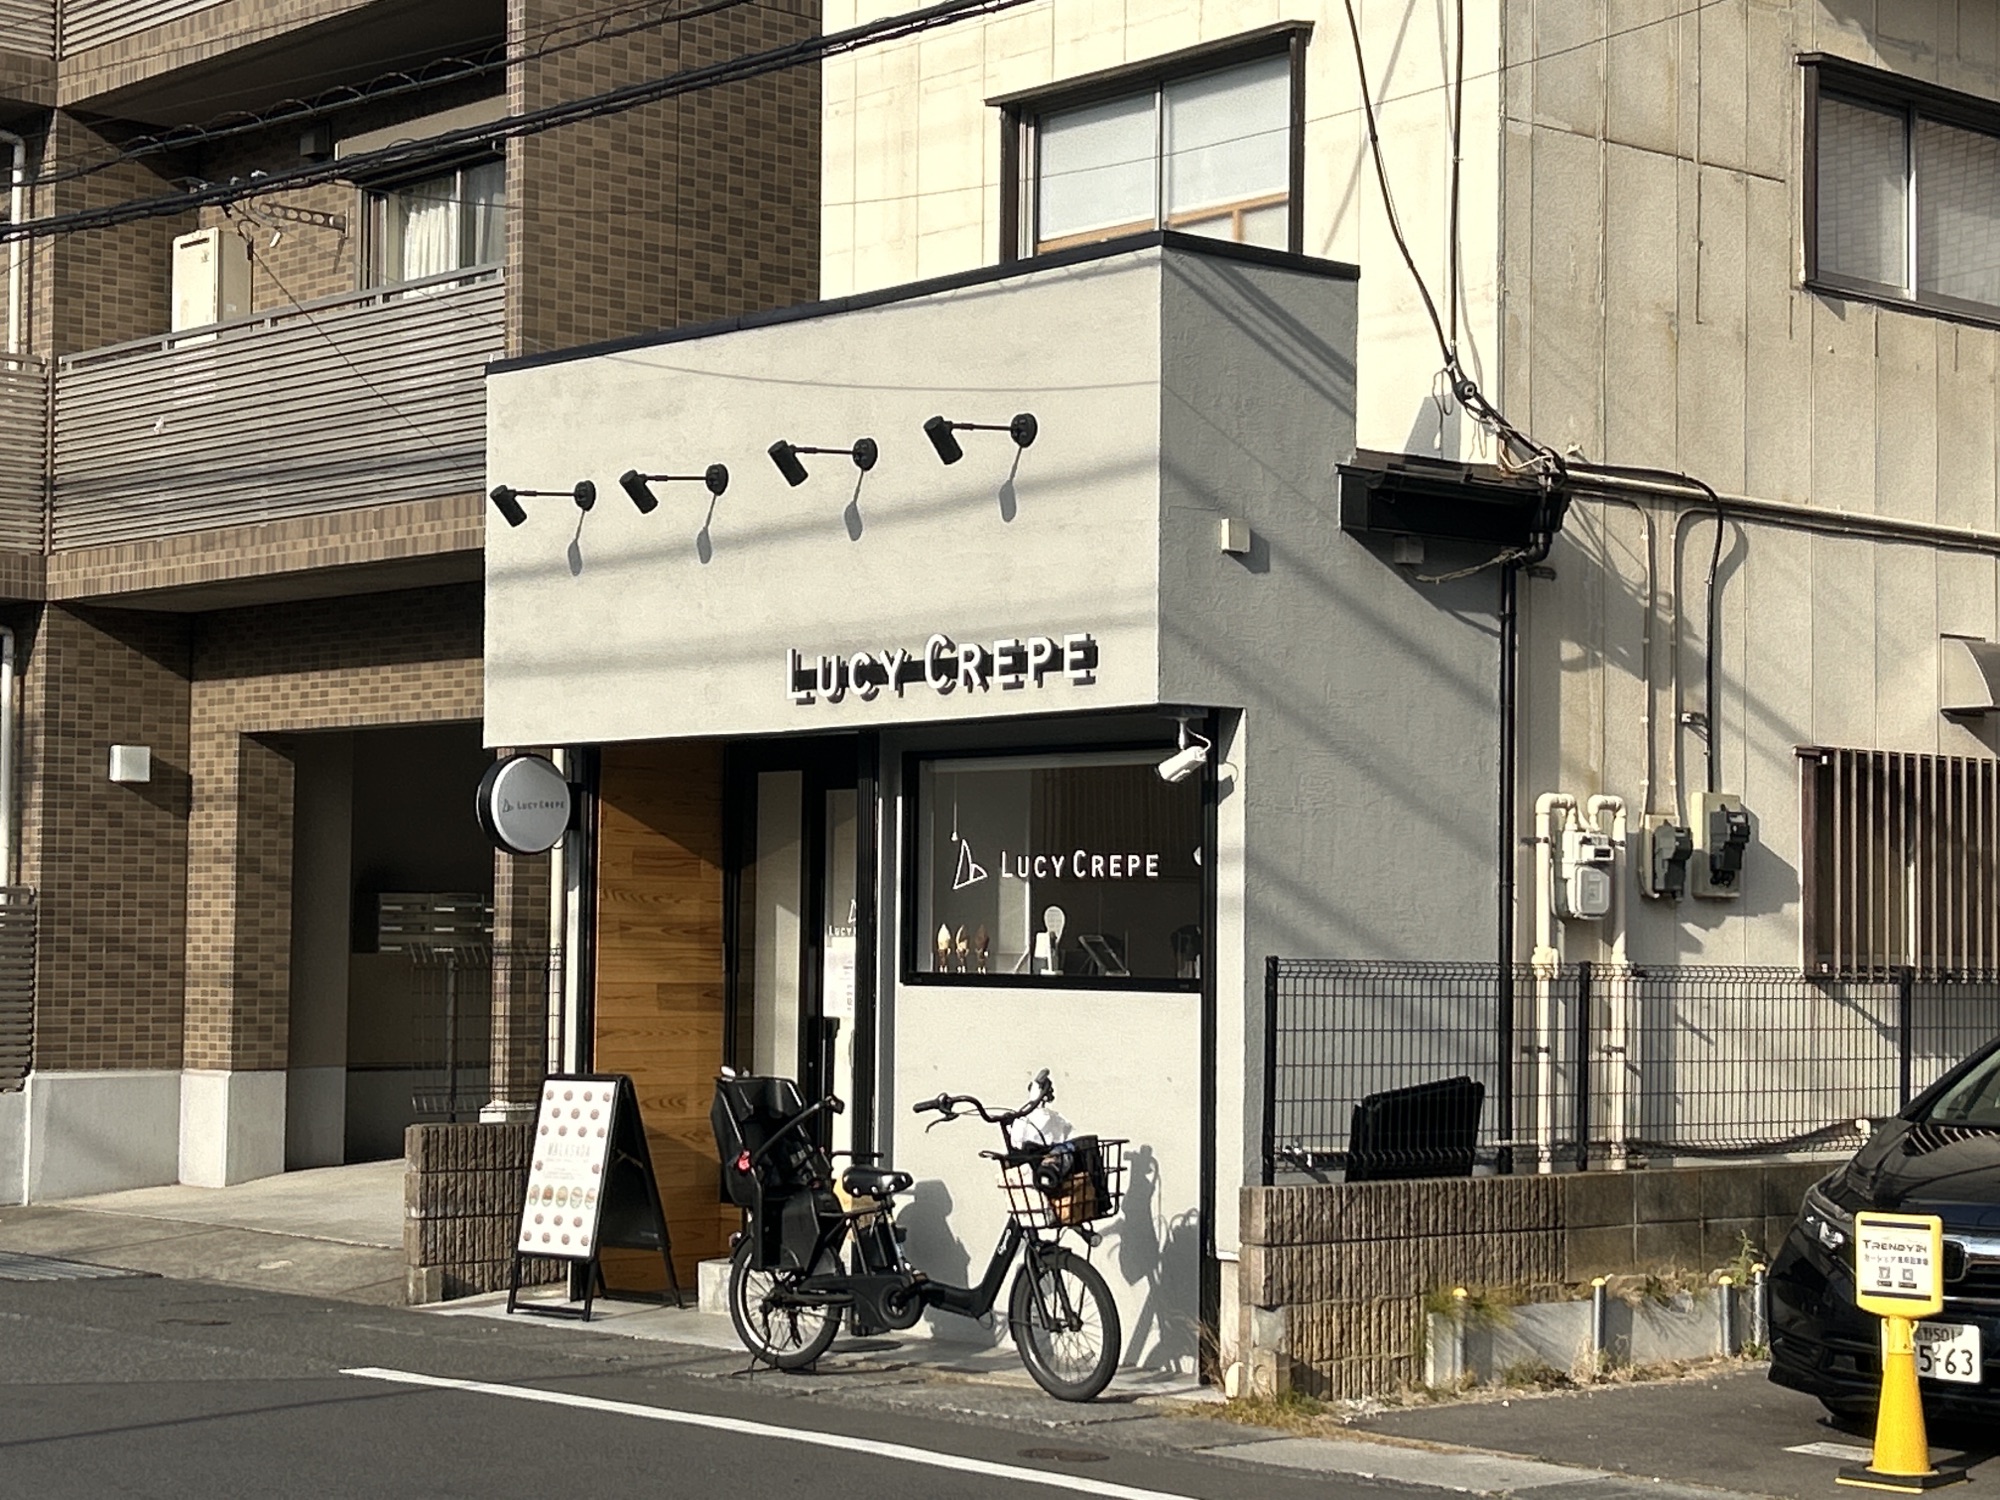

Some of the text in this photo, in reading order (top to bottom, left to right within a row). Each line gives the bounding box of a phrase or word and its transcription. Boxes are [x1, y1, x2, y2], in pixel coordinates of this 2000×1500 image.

[786, 633, 1092, 700] LUCY CREPE
[517, 801, 538, 810] LUCY
[1001, 849, 1160, 879] LUCY CREPE
